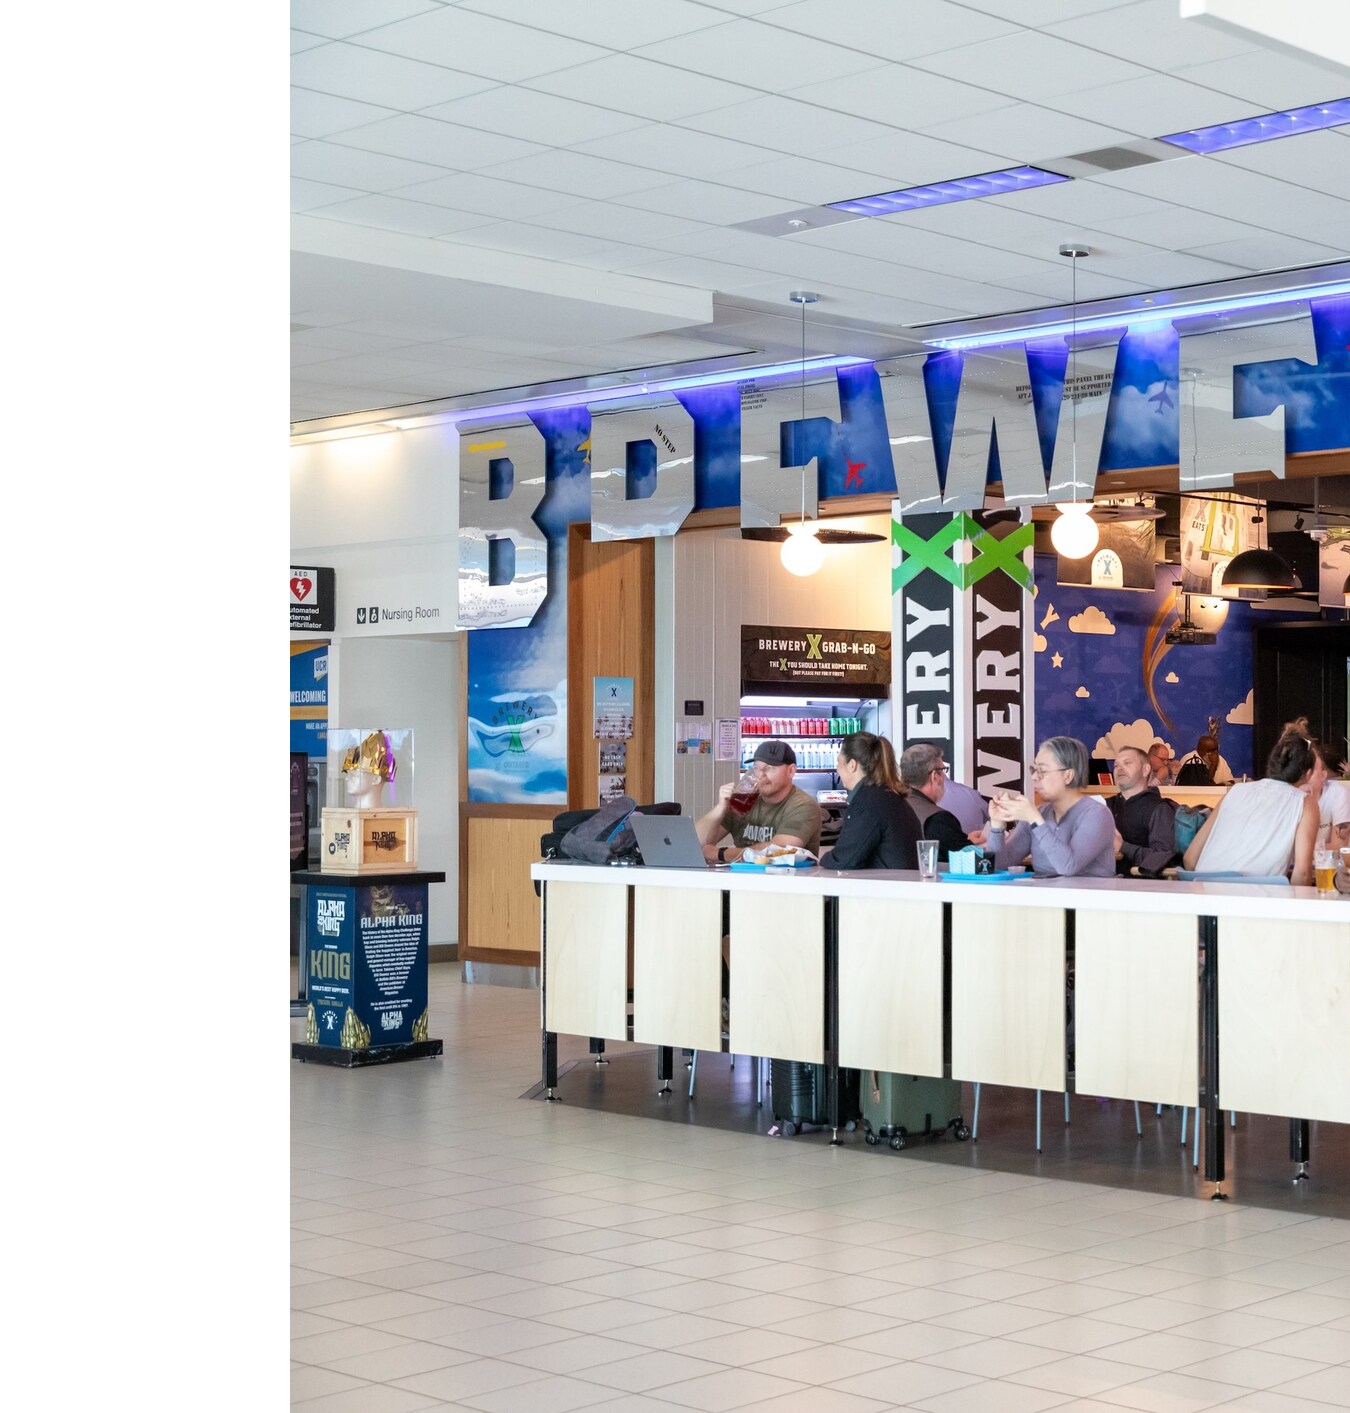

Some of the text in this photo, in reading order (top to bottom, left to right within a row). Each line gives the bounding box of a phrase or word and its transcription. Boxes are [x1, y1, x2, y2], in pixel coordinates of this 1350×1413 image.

[1081, 382, 1111, 390] SUPPORTED
[654, 424, 676, 454] NO STEP
[1192, 520, 1205, 532] EATS
[382, 607, 440, 622] Nursing Room
[759, 634, 876, 659] BREWERY X GRAB-N-GO
[315, 660, 327, 672] UCR
[779, 658, 787, 671] X
[290, 690, 326, 703] WELCOMING
[492, 700, 540, 726] BREWERY
[317, 900, 345, 917] ALPHA
[361, 914, 422, 928] ALPHA KING
[311, 950, 350, 980] KING
[327, 1016, 333, 1029] X
